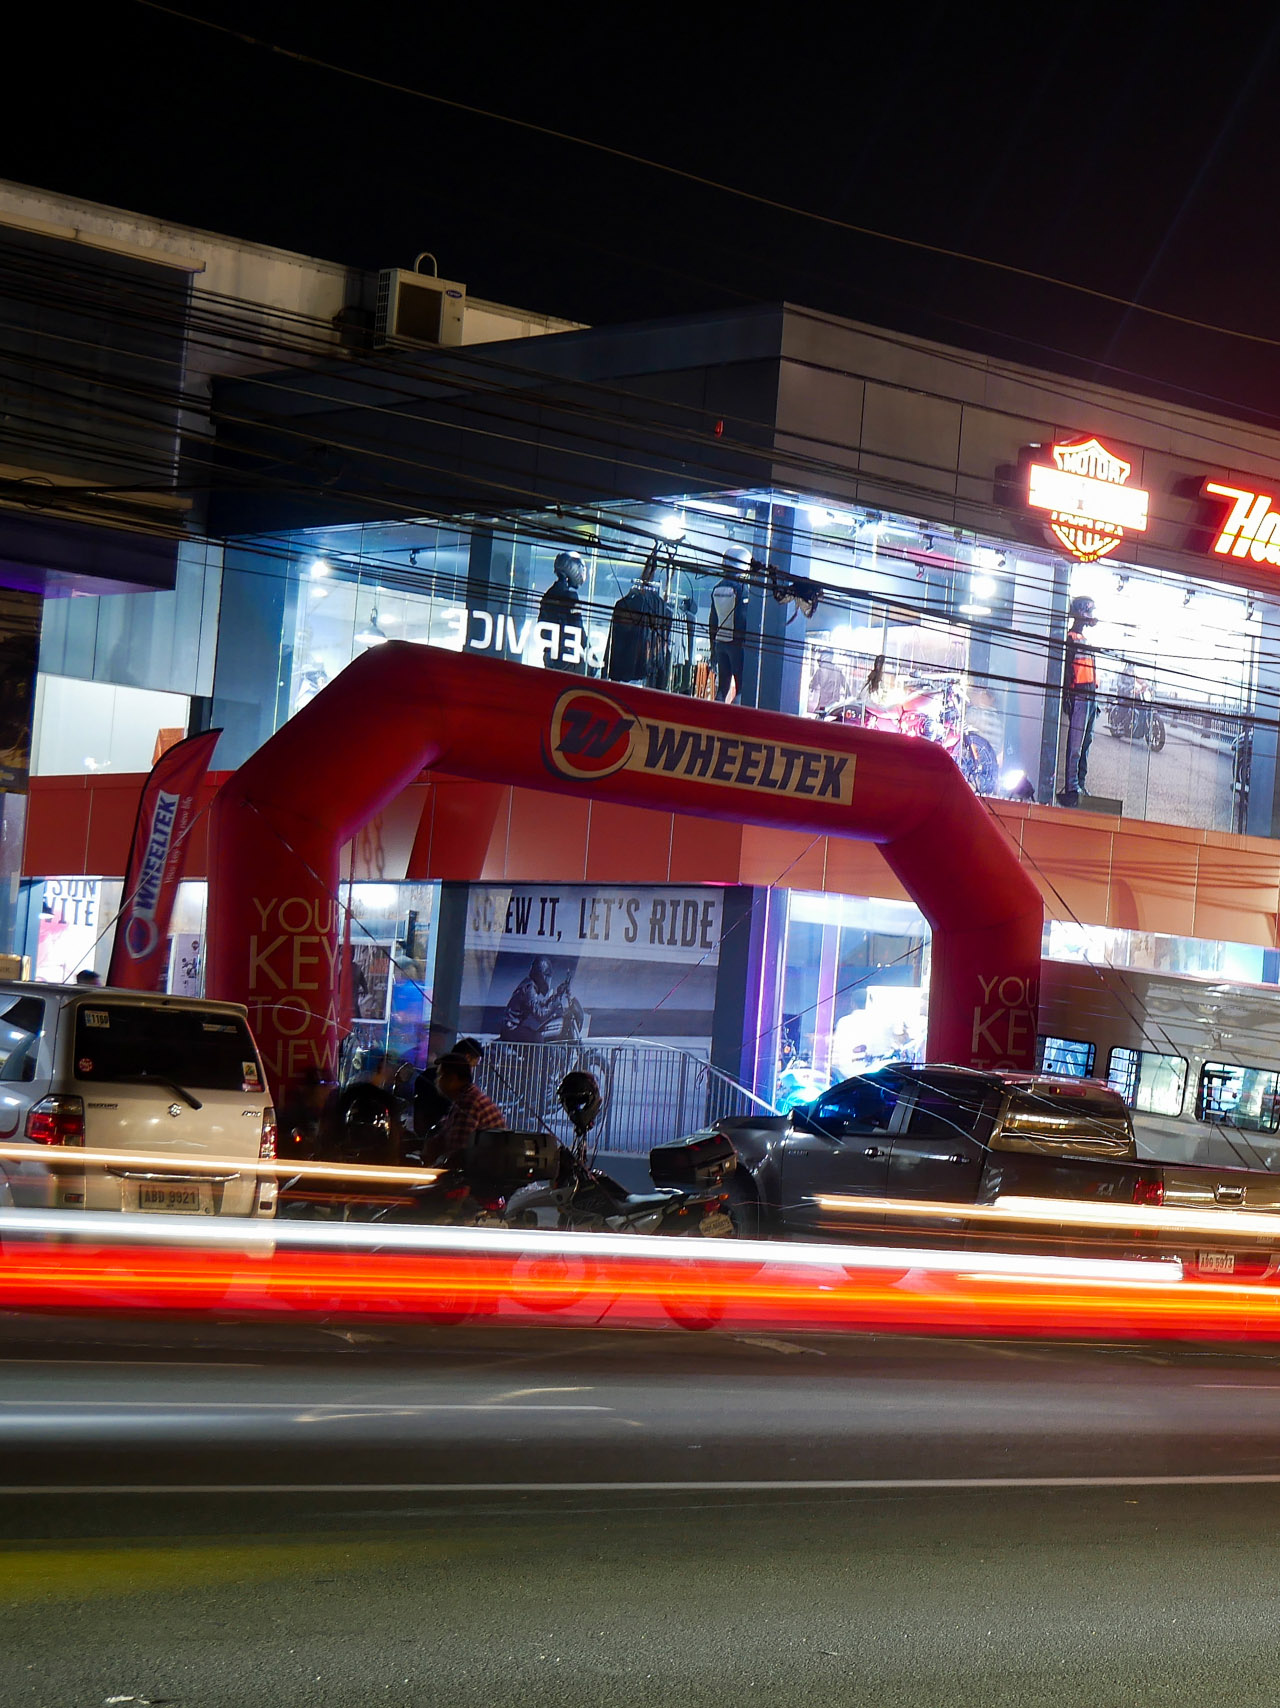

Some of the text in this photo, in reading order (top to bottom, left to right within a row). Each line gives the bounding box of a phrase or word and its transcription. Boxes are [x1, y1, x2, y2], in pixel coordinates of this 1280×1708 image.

[643, 723, 849, 799] WHEELTEK
[135, 796, 177, 910] WHEELTEK
[472, 895, 716, 949] SCREW IT, LET'S RIDE
[248, 934, 339, 990] KEY
[248, 995, 311, 1036] TO
